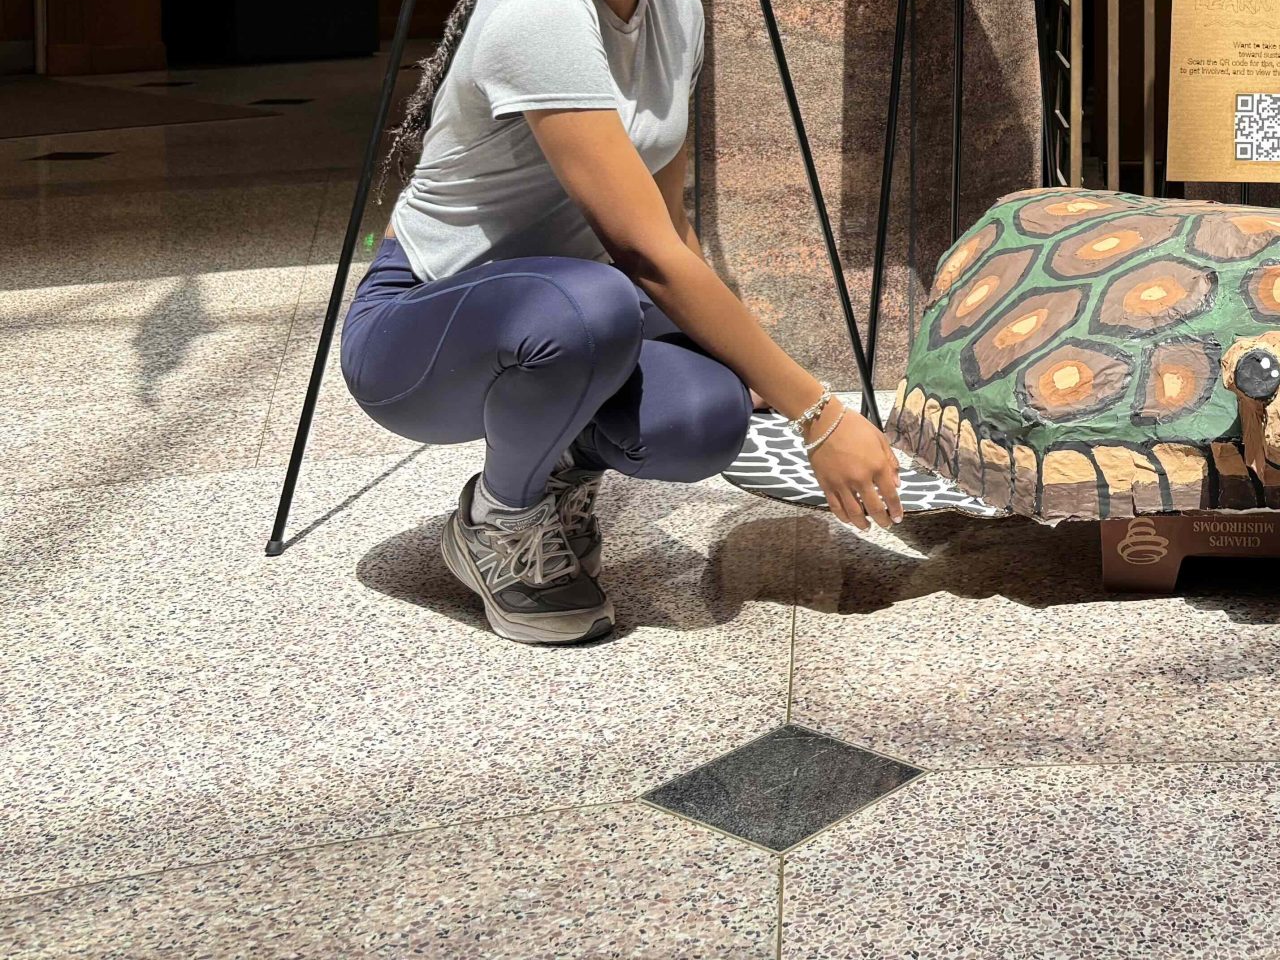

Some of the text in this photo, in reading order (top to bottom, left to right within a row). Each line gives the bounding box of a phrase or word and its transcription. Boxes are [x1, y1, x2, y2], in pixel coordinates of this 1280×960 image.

[1233, 41, 1251, 49] Want
[1262, 42, 1277, 50] take
[1206, 58, 1217, 66] the
[1219, 59, 1229, 67] QR
[1261, 60, 1274, 69] tips,
[1202, 67, 1230, 75] involved,
[1193, 520, 1274, 534] MUSHROOMS
[1209, 535, 1261, 547] CHAMPS
